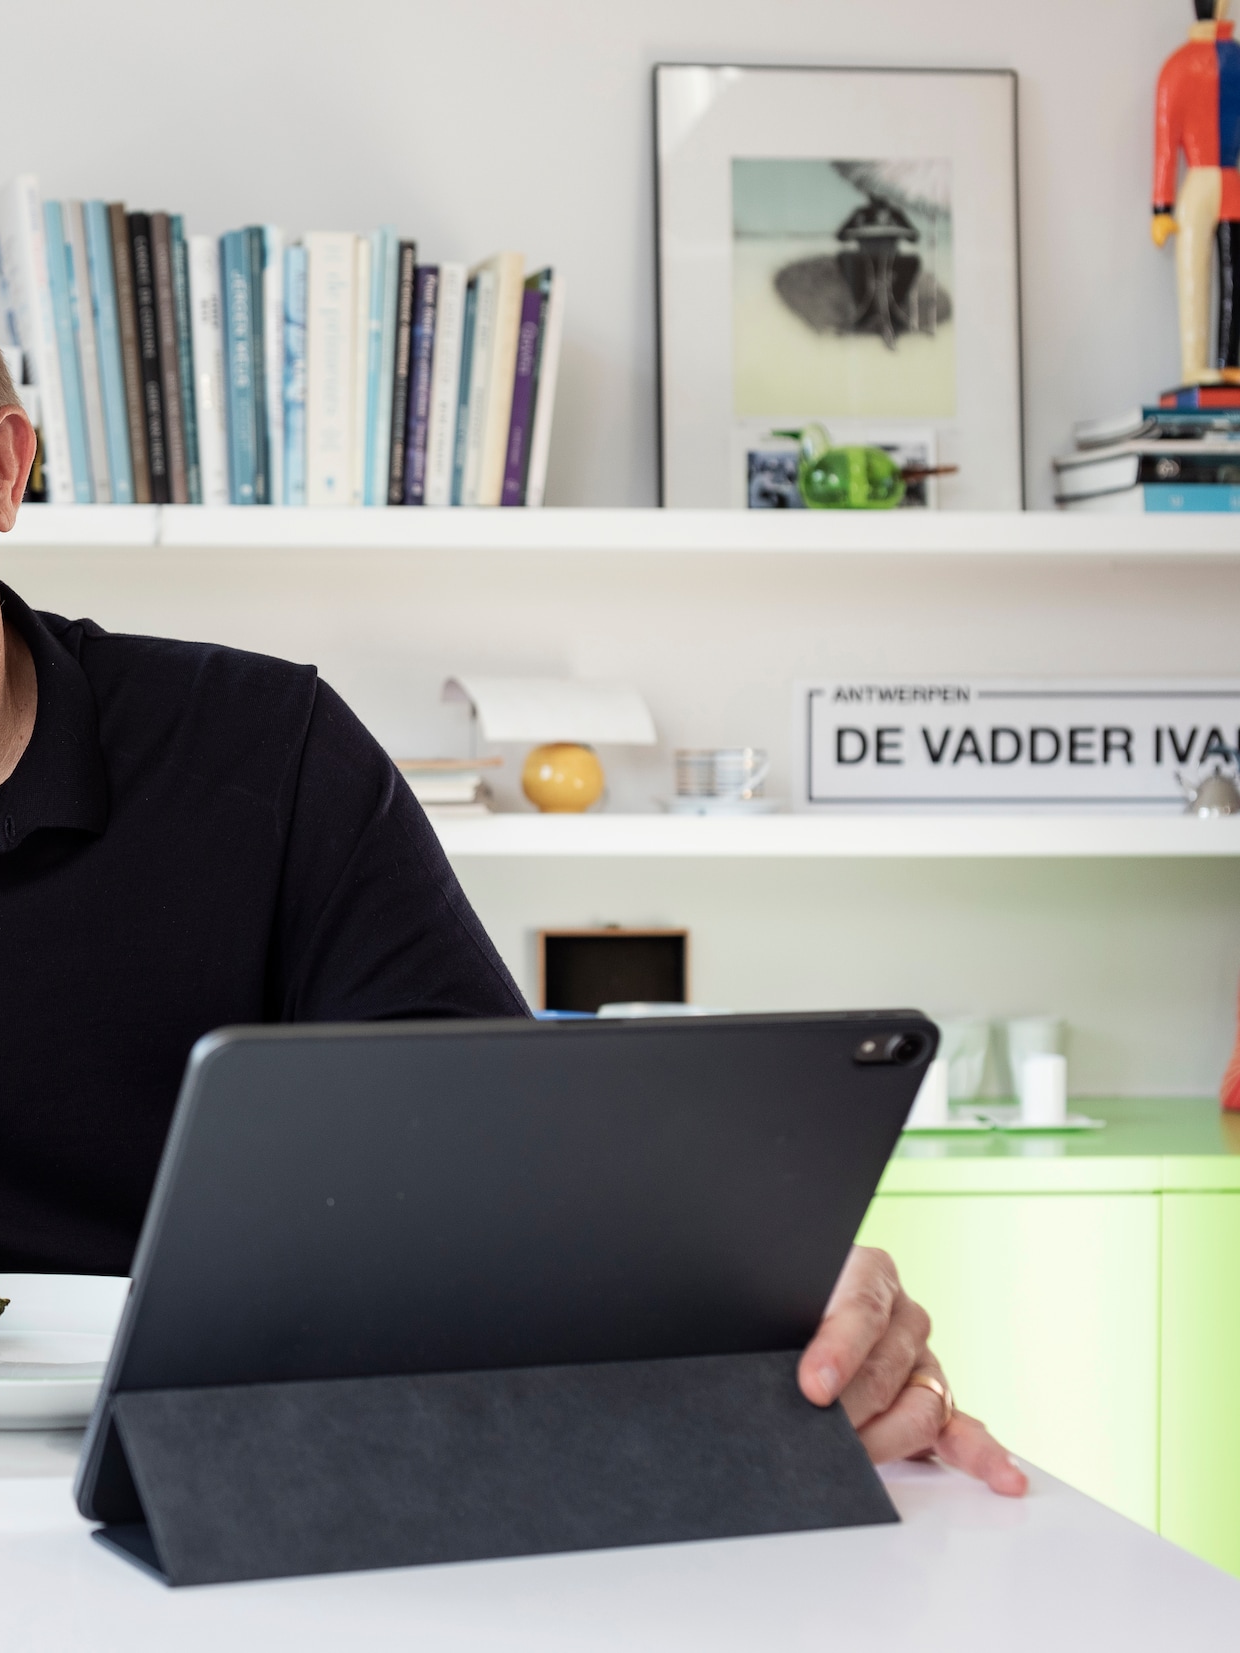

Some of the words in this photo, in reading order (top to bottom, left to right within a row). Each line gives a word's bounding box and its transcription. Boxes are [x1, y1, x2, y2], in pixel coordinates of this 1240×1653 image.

[832, 686, 971, 705] ANTWERPEN
[835, 726, 904, 765] DE
[922, 726, 1134, 765] VADDER
[1154, 726, 1240, 765] IVA
